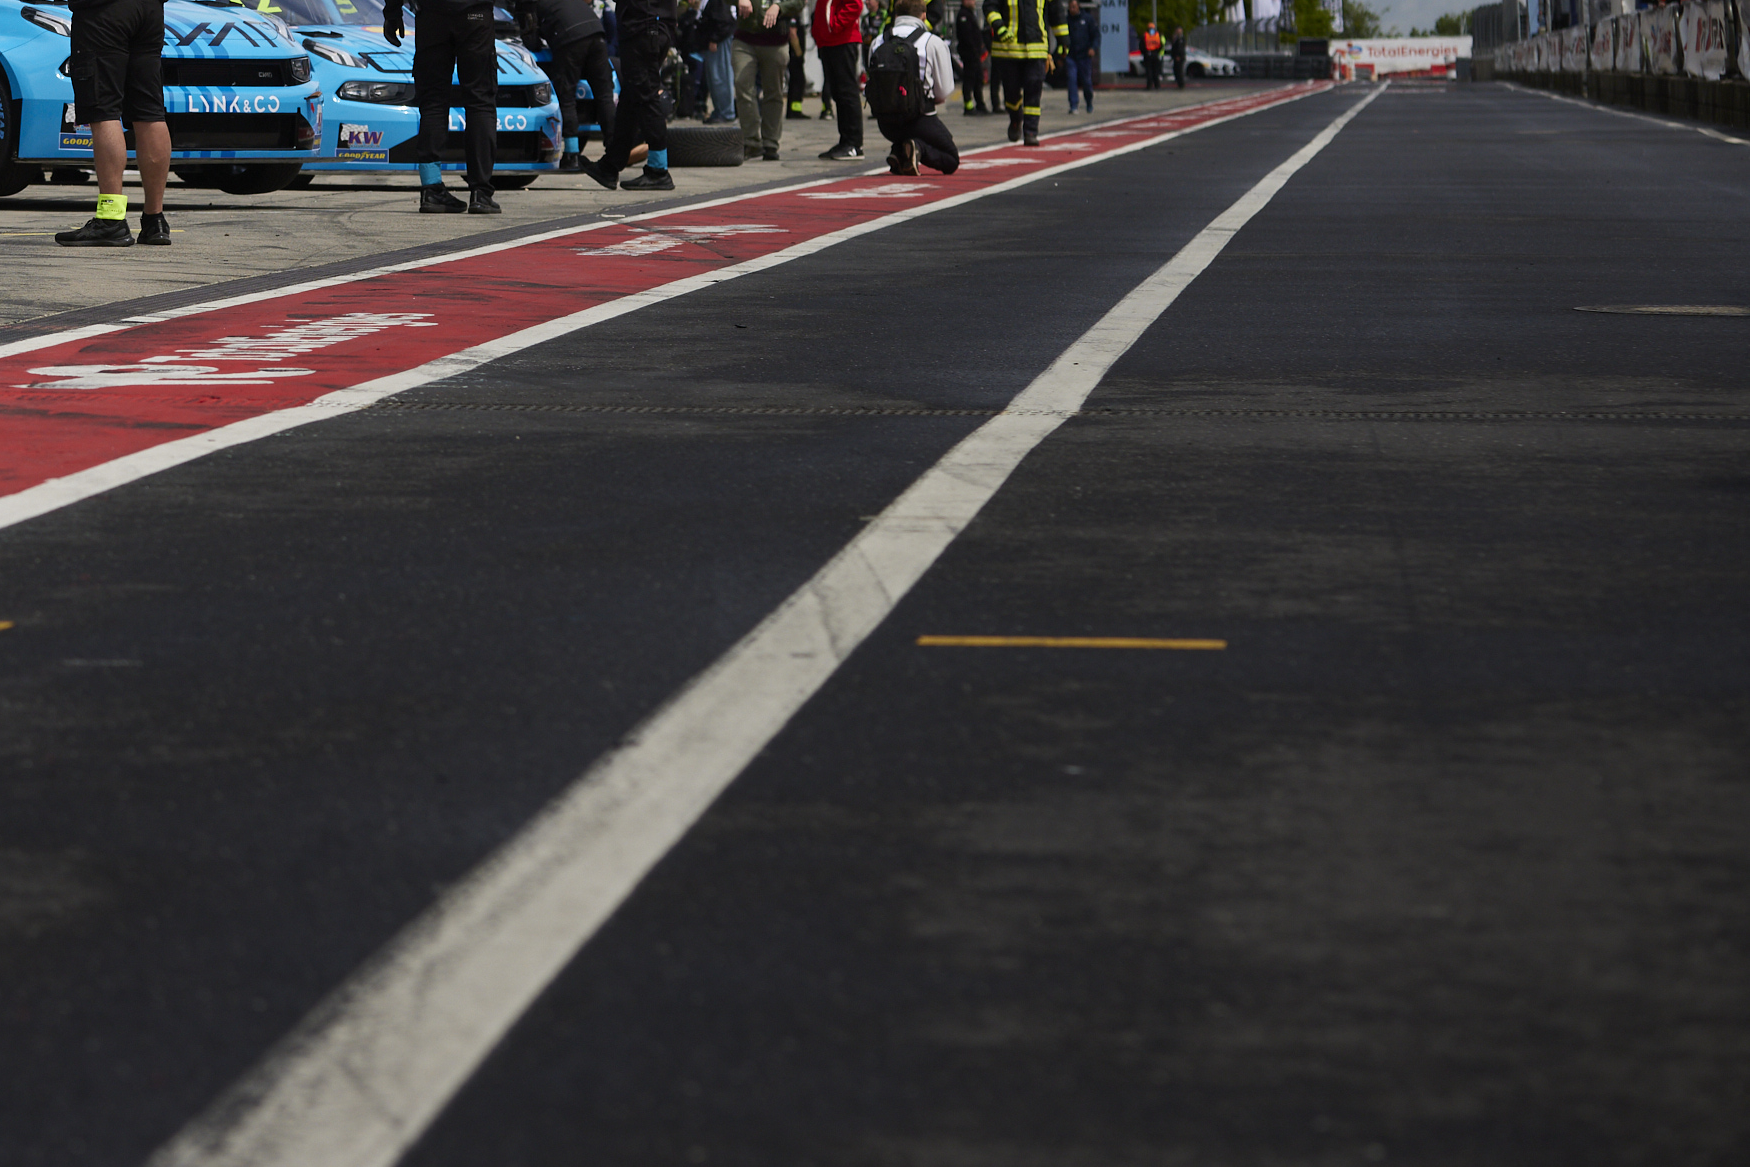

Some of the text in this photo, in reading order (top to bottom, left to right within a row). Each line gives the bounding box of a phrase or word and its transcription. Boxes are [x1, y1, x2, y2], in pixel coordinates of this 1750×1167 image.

[1367, 44, 1459, 60] TotalEnergies
[189, 95, 280, 113] LYNK&CO
[348, 131, 383, 146] KW
